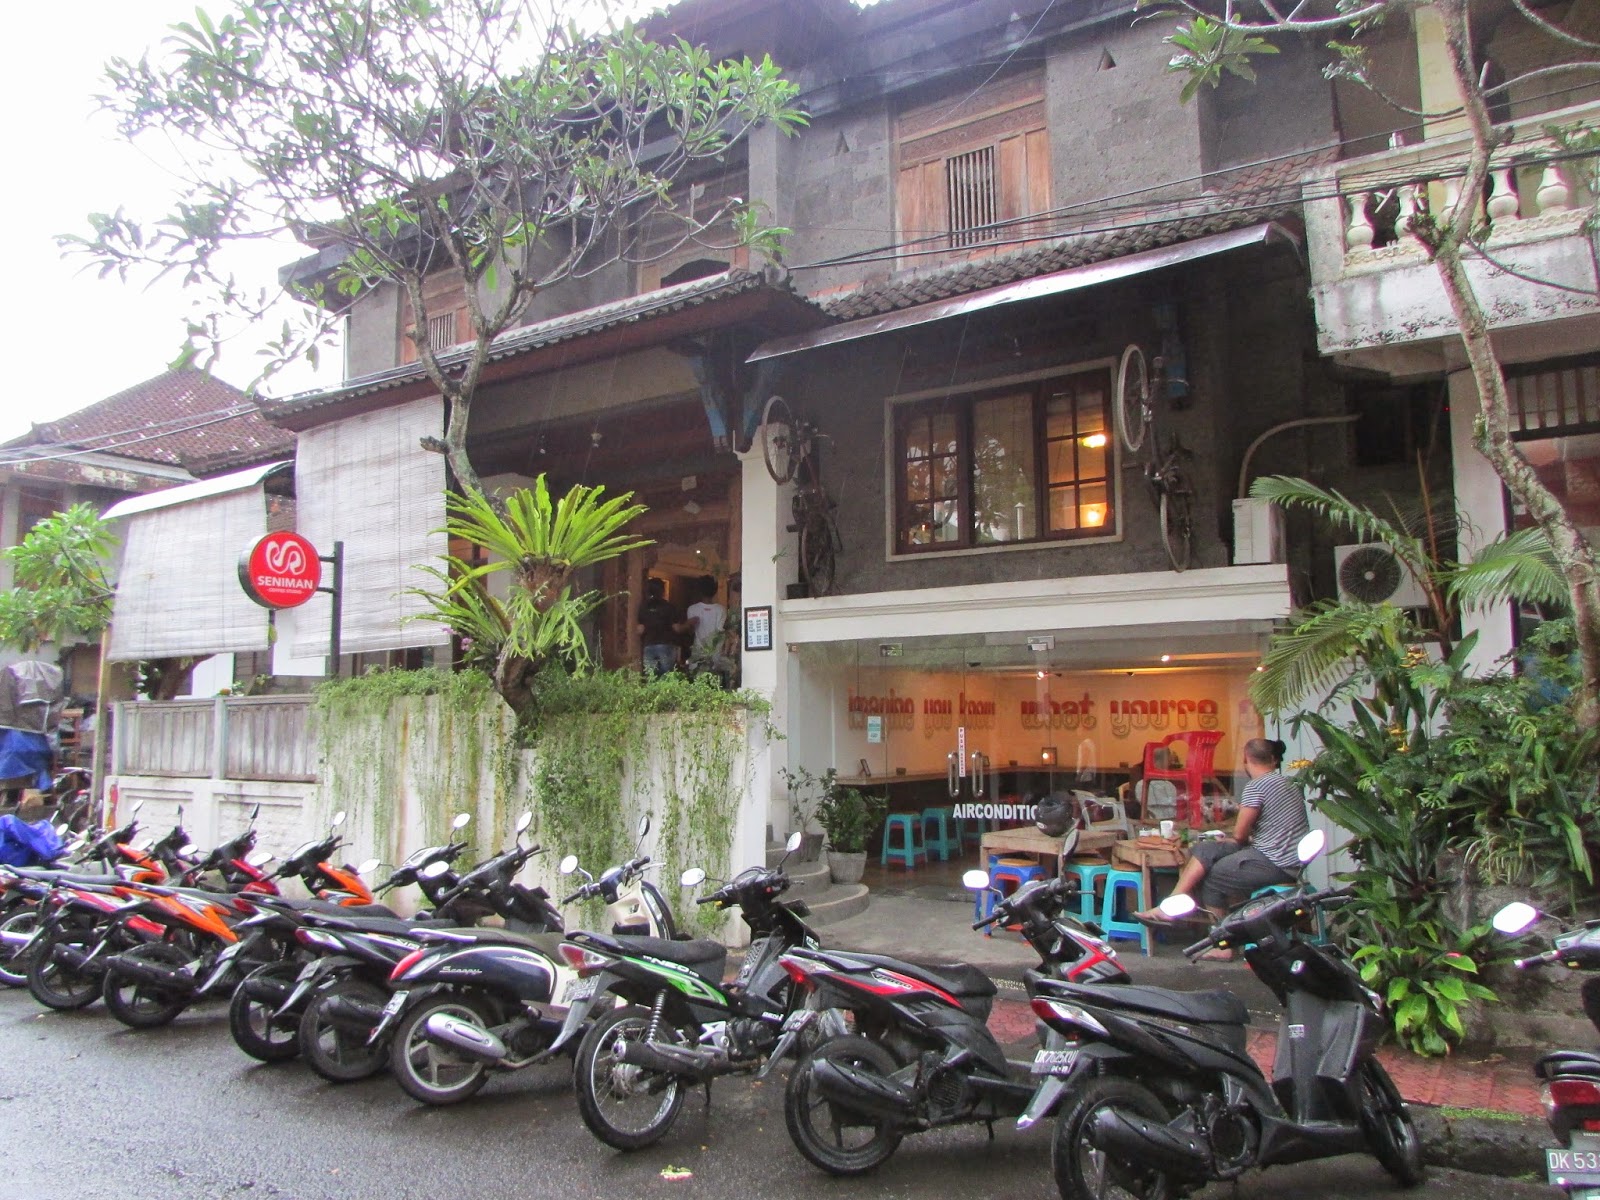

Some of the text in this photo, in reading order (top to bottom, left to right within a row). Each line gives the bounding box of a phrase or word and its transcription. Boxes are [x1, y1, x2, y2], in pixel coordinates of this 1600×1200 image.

[257, 575, 314, 589] SENIMAN
[1021, 692, 1097, 729] what
[439, 966, 482, 976] Scoopy
[651, 957, 690, 973] NEO
[1549, 1152, 1600, 1169] DK 53
